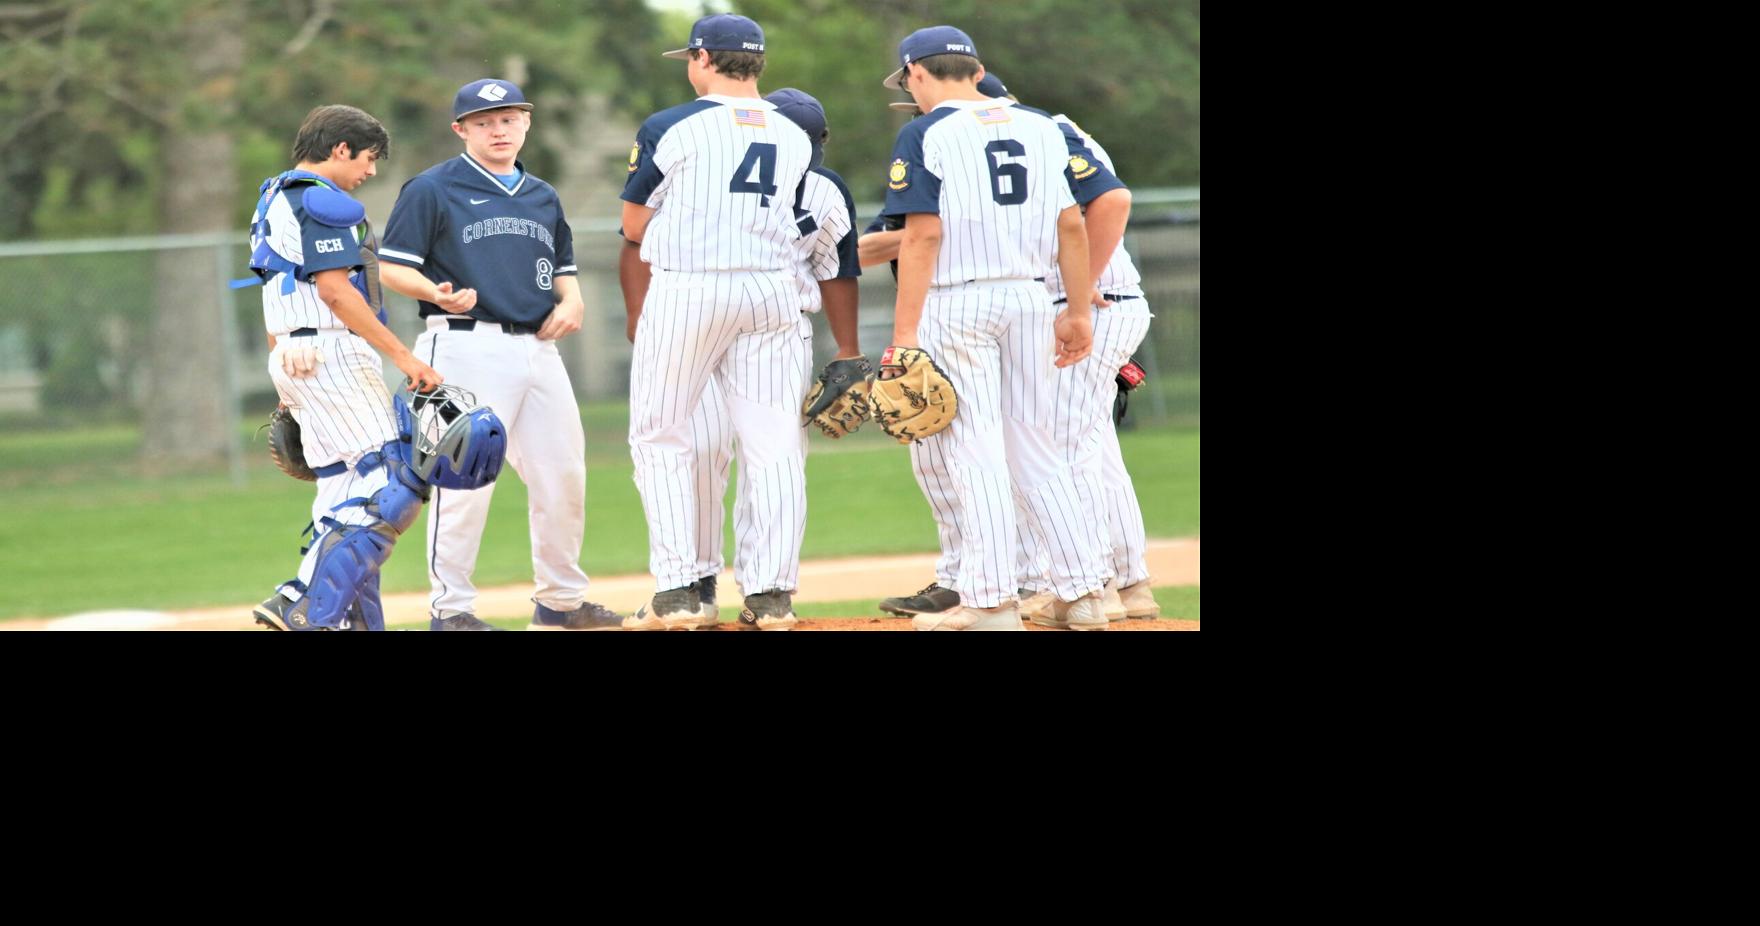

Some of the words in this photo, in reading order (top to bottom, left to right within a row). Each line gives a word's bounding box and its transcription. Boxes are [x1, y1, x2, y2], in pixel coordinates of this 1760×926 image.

[743, 42, 758, 50] POST
[946, 43, 964, 51] POST
[729, 142, 777, 207] 4
[985, 139, 1028, 206] 6
[315, 238, 344, 253] GCH
[536, 258, 553, 290] 8
